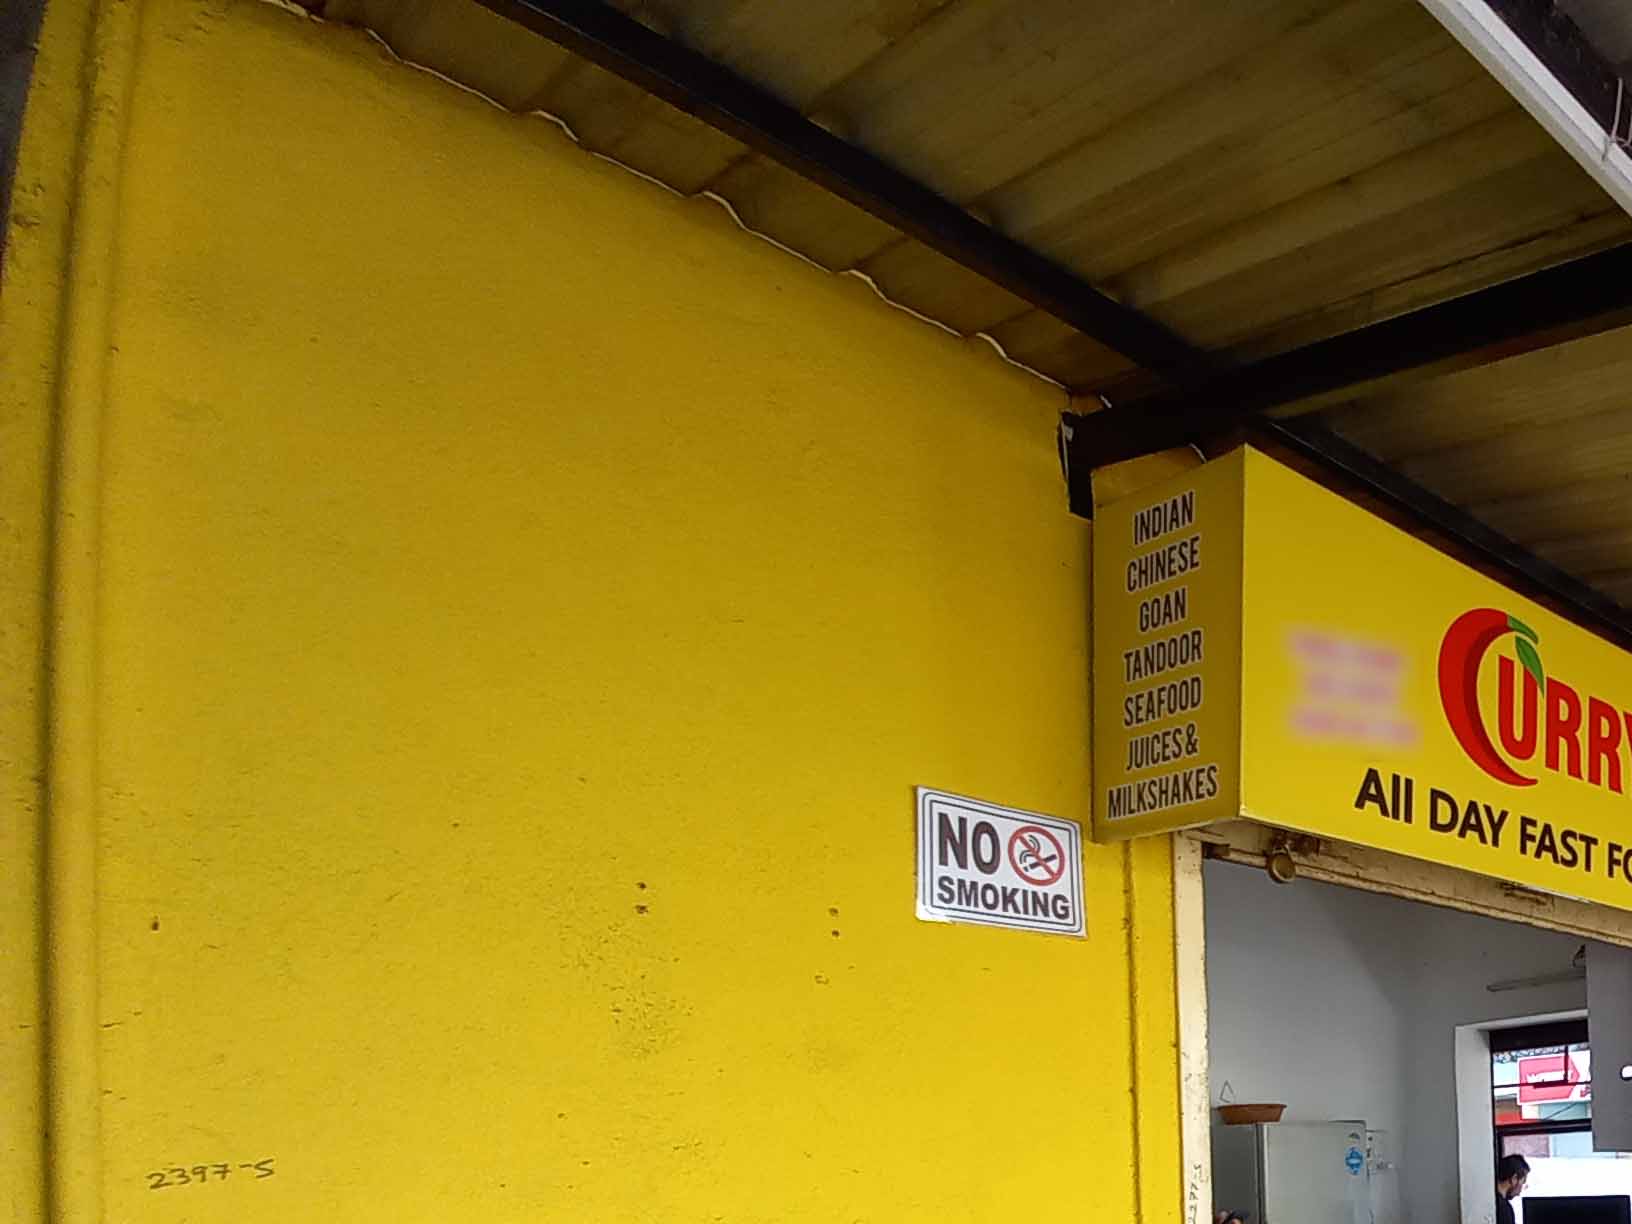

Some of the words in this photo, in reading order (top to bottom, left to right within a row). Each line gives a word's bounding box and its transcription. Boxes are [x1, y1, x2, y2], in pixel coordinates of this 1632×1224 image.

[1134, 491, 1195, 546] INDIAN
[1127, 536, 1201, 593] CHINESE
[1139, 587, 1187, 633] GOAN
[1123, 629, 1203, 683] TANDOOR
[1124, 676, 1202, 728] SEAFOOD
[1107, 765, 1218, 819] MILKSHAKES
[938, 812, 1000, 875] NO
[1429, 787, 1509, 848] DAY
[1520, 815, 1599, 873] FAST
[937, 875, 1071, 920] SMOKING
